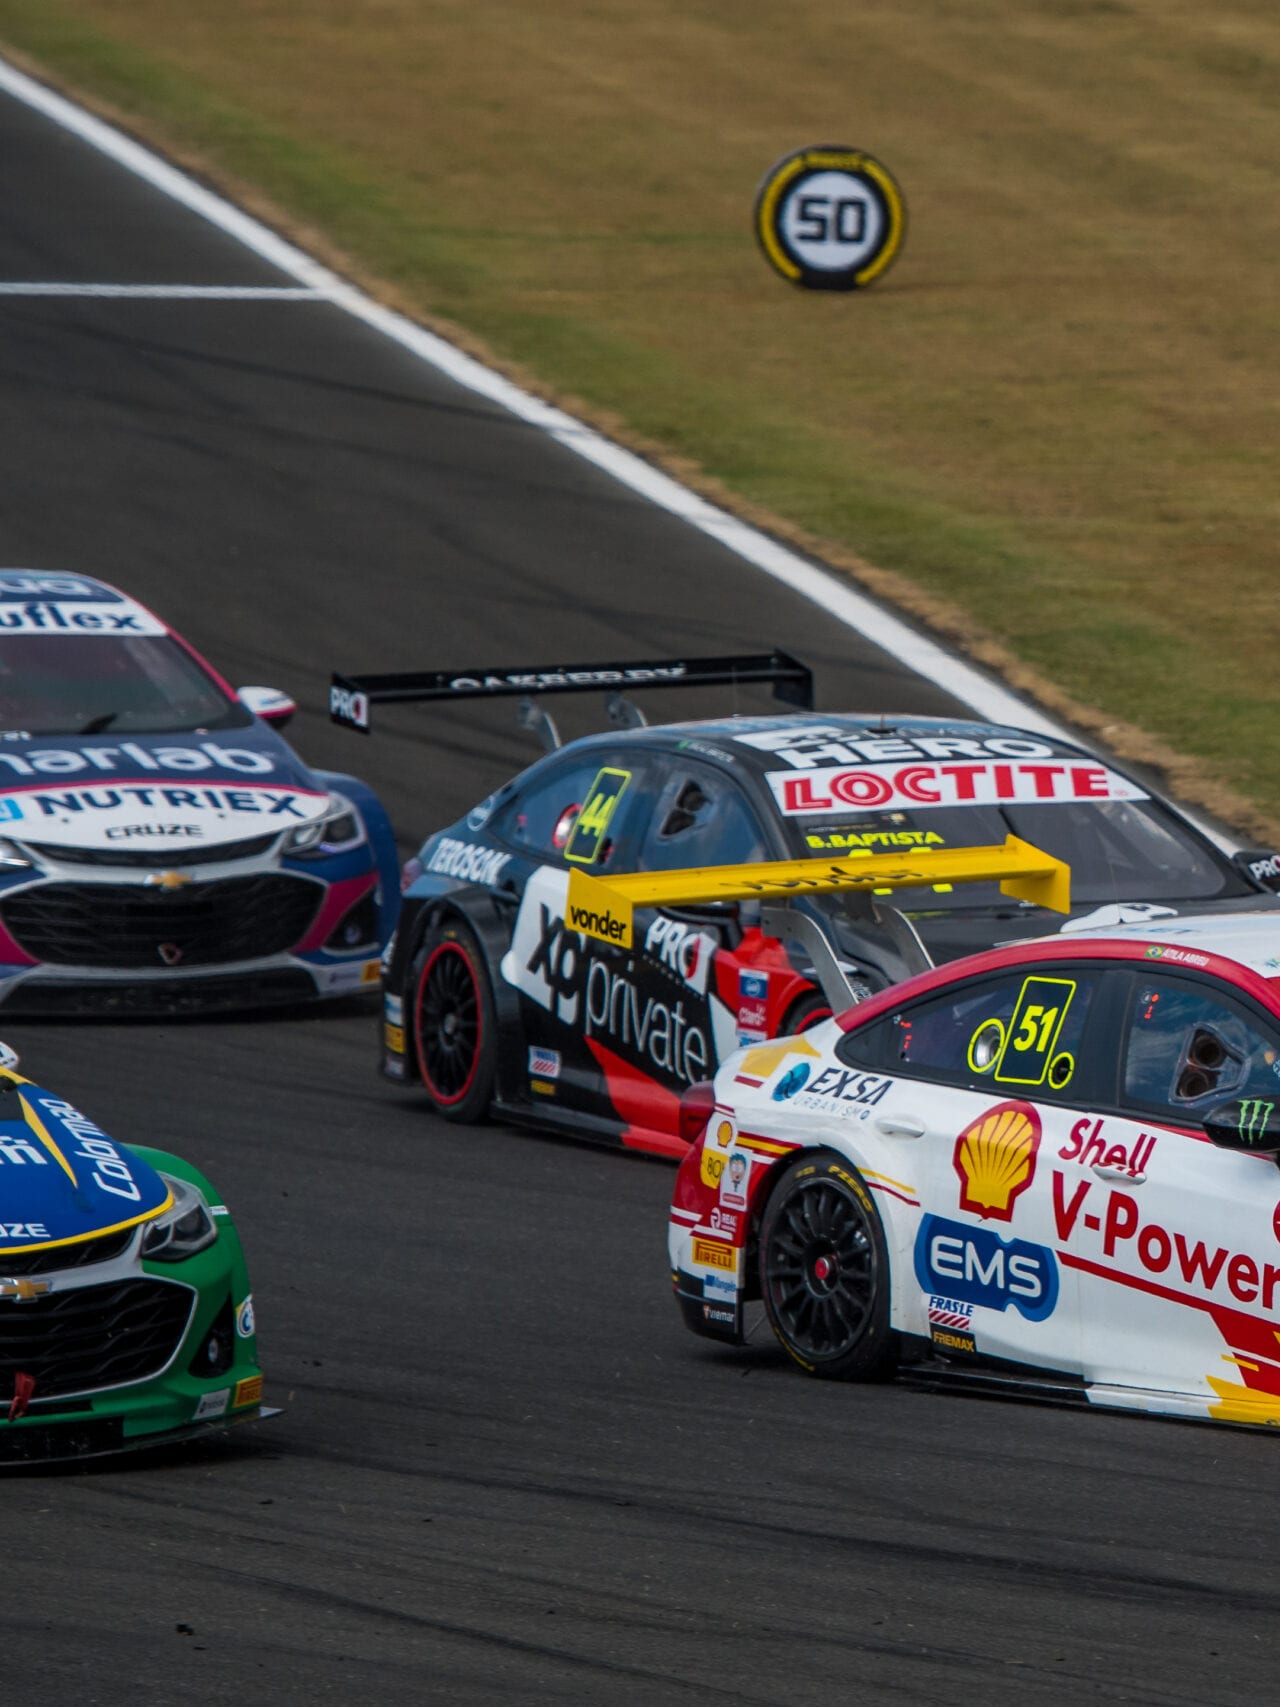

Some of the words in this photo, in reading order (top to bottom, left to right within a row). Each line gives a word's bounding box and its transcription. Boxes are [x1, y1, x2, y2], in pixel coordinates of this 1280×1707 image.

[796, 197, 866, 243] 50
[773, 737, 1053, 769] HERO
[33, 788, 306, 818] NUTRIEX
[784, 764, 1110, 811] LOCTITE
[105, 823, 204, 840] CRUZE
[805, 831, 945, 849] B.BAPTISTA
[570, 905, 627, 940] vonder
[586, 956, 708, 1087] private
[1014, 1005, 1059, 1053] 51
[804, 1067, 894, 1106] EXSA
[1058, 1117, 1158, 1178] Shell
[695, 1240, 733, 1268] PIRELLI
[931, 1235, 1043, 1298] EMS
[933, 1331, 974, 1353] FREMAX
